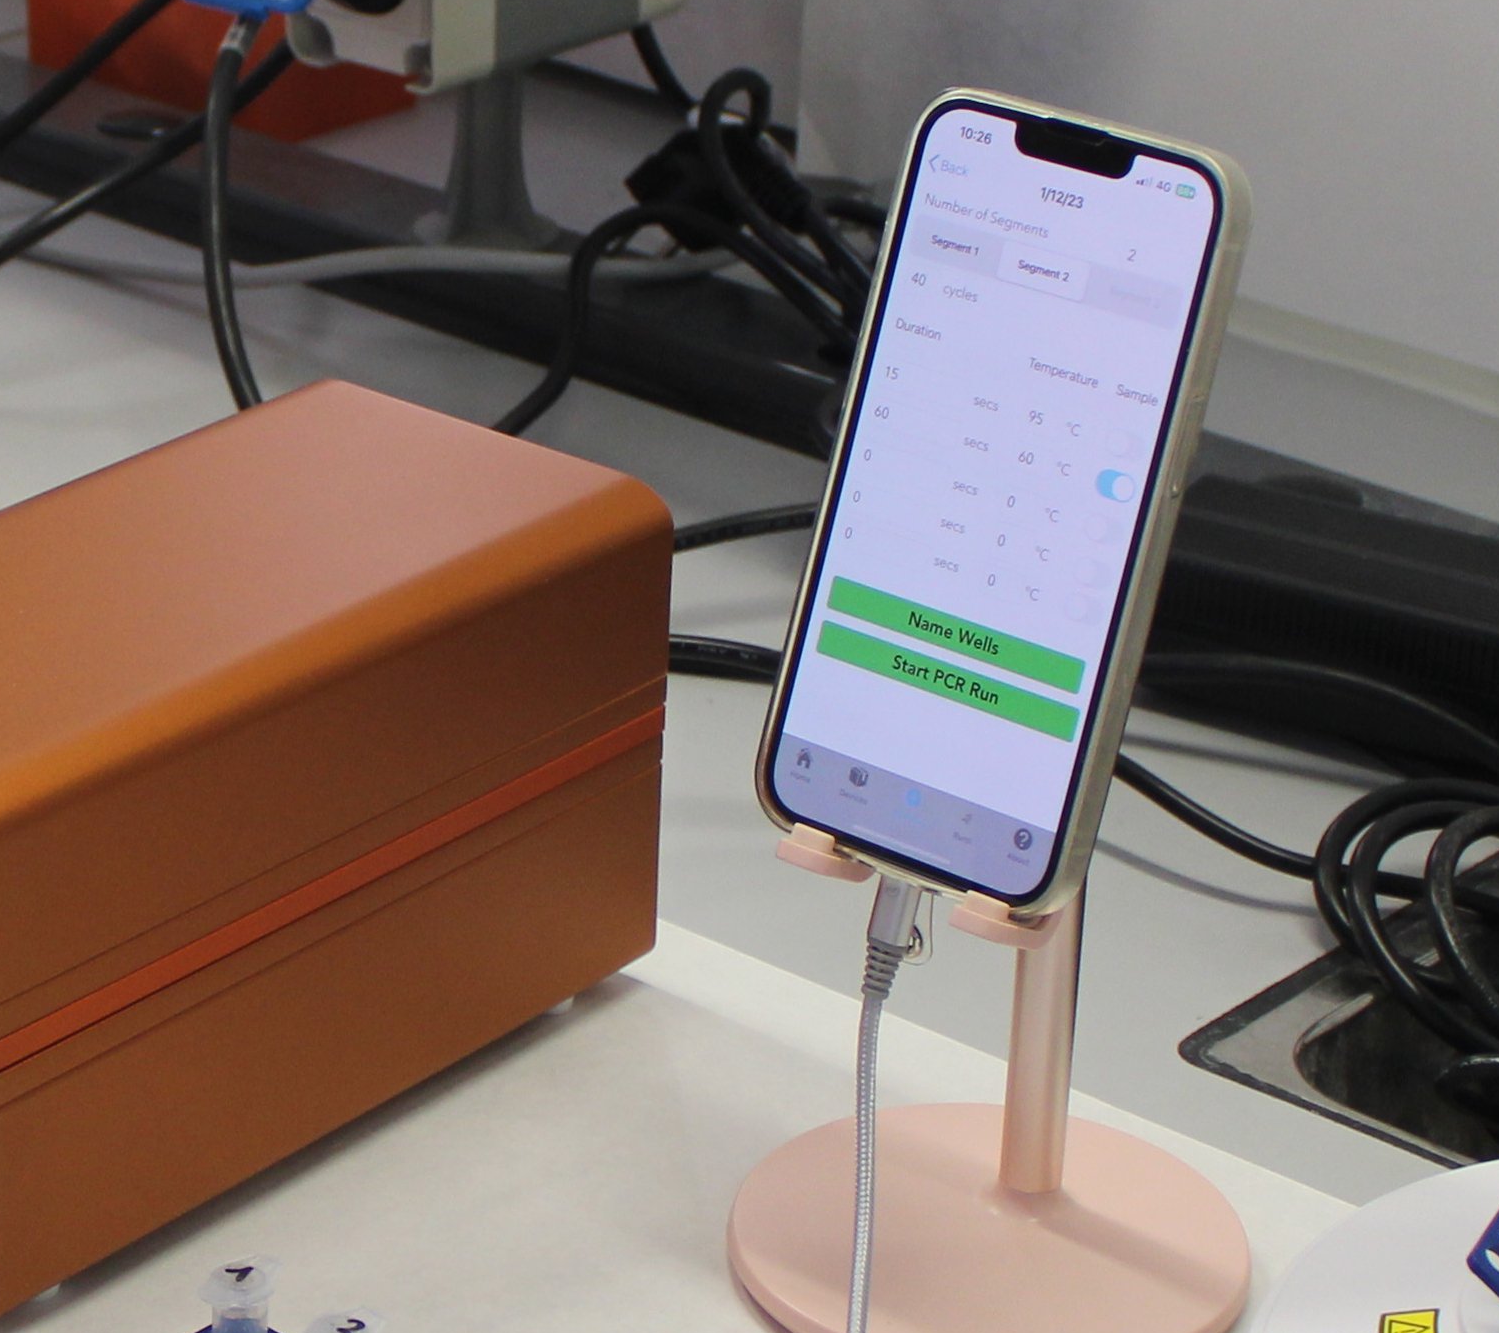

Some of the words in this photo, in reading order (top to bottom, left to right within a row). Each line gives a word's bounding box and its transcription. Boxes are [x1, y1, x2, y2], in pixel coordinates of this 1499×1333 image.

[960, 125, 992, 145] 10:26
[940, 160, 969, 177] Back
[925, 193, 972, 217] Number
[975, 208, 989, 221] of
[991, 212, 1049, 238] Segments
[1040, 186, 1084, 209] 1/12/23
[931, 234, 972, 255] Segment
[1127, 248, 1137, 263] 2
[911, 271, 927, 287] 40
[942, 283, 978, 303] cycles
[1017, 259, 1059, 281] Segment
[1061, 271, 1070, 283] 2
[895, 317, 942, 341] Duration
[885, 366, 899, 380] 15
[973, 395, 999, 412] secs
[1028, 410, 1044, 425] 95
[1028, 357, 1099, 389] Temperature
[1116, 384, 1159, 408] Sample
[874, 406, 890, 420] 60
[963, 435, 989, 452] secs
[1018, 450, 1034, 465] 60
[863, 448, 872, 462] 0
[952, 479, 978, 496] secs
[1007, 495, 1016, 509] 0
[852, 490, 861, 503] 0
[940, 517, 966, 534] secs
[997, 533, 1006, 547] 0
[844, 526, 853, 540] 0
[933, 555, 959, 573] secs
[987, 573, 996, 587] 0
[907, 610, 953, 640] Name
[958, 627, 999, 656] Wells
[892, 655, 929, 680] Start
[933, 668, 966, 692] PCR
[969, 682, 999, 705] Run
